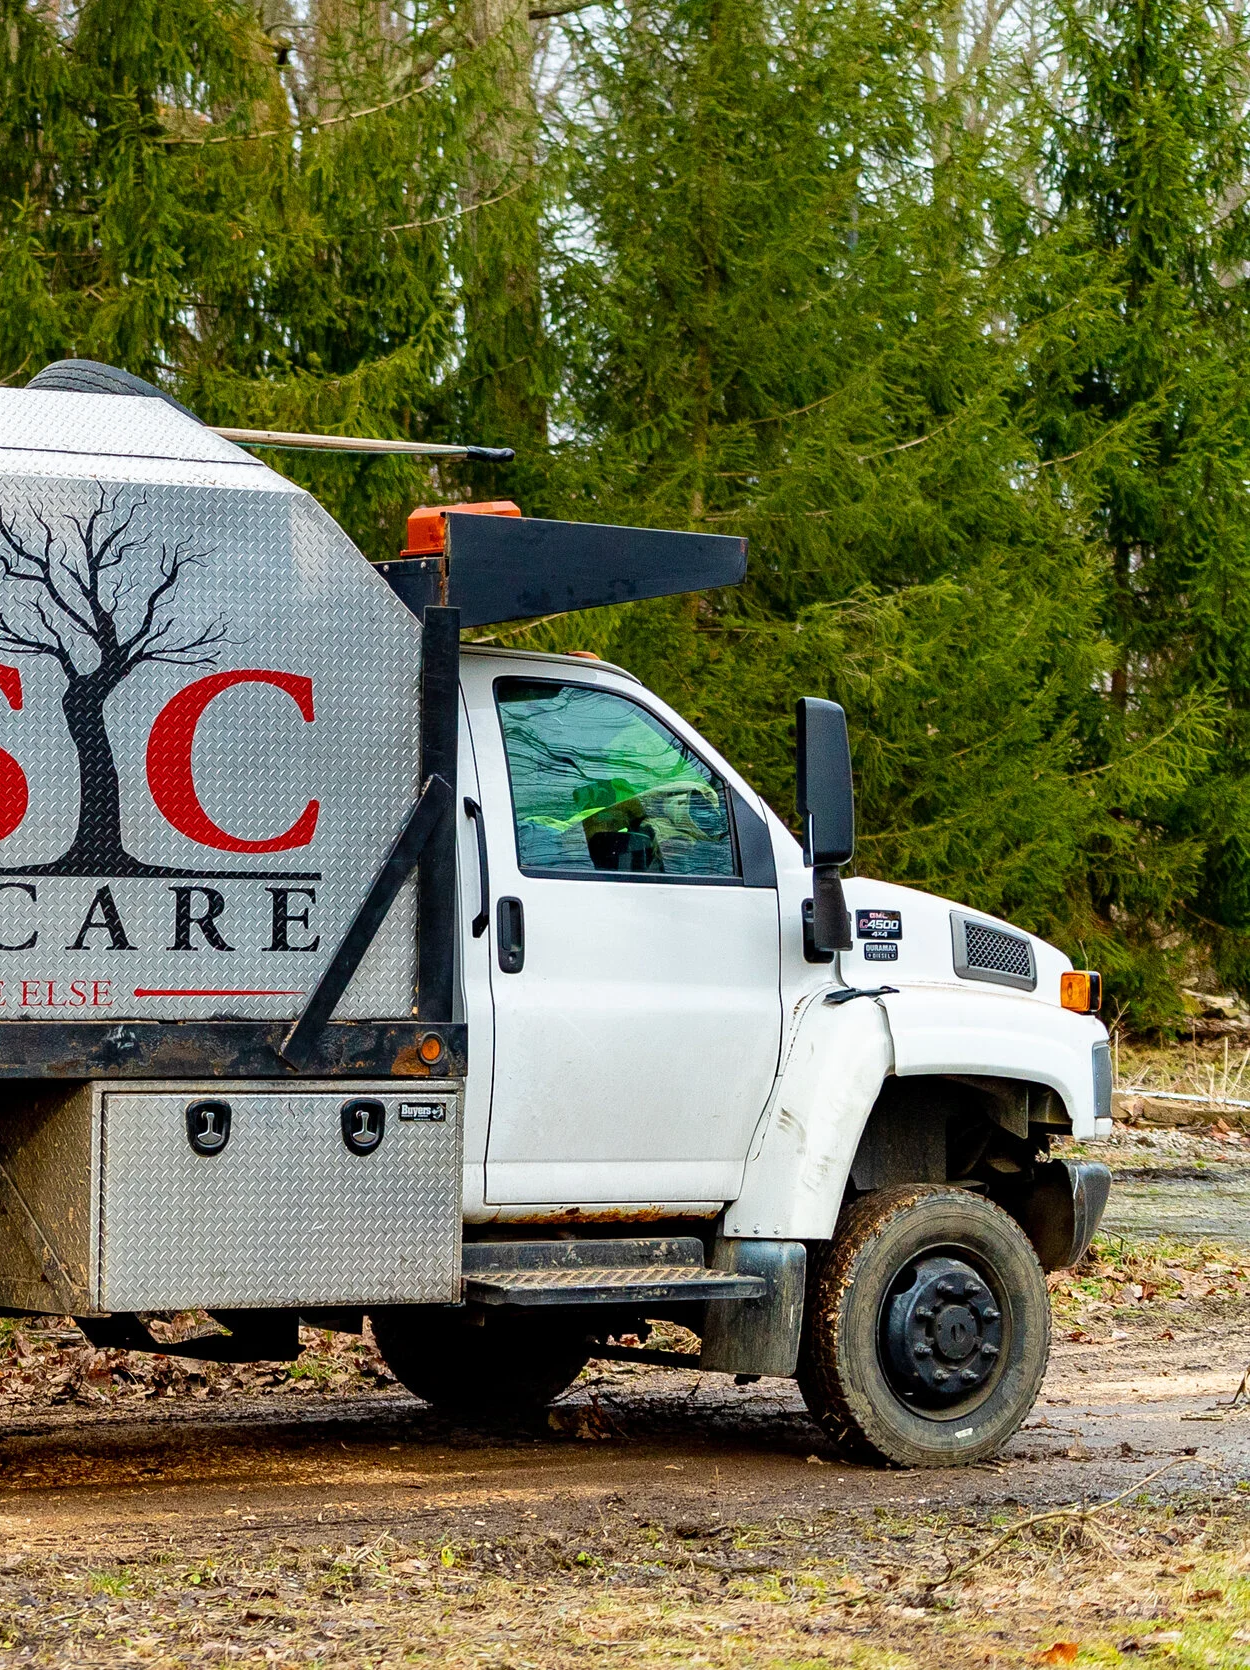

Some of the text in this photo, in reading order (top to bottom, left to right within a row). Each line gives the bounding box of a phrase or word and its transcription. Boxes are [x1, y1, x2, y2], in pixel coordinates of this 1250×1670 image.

[860, 919, 899, 929] C4500
[21, 979, 115, 1008] ELSE
[402, 1105, 431, 1117] Buyers
